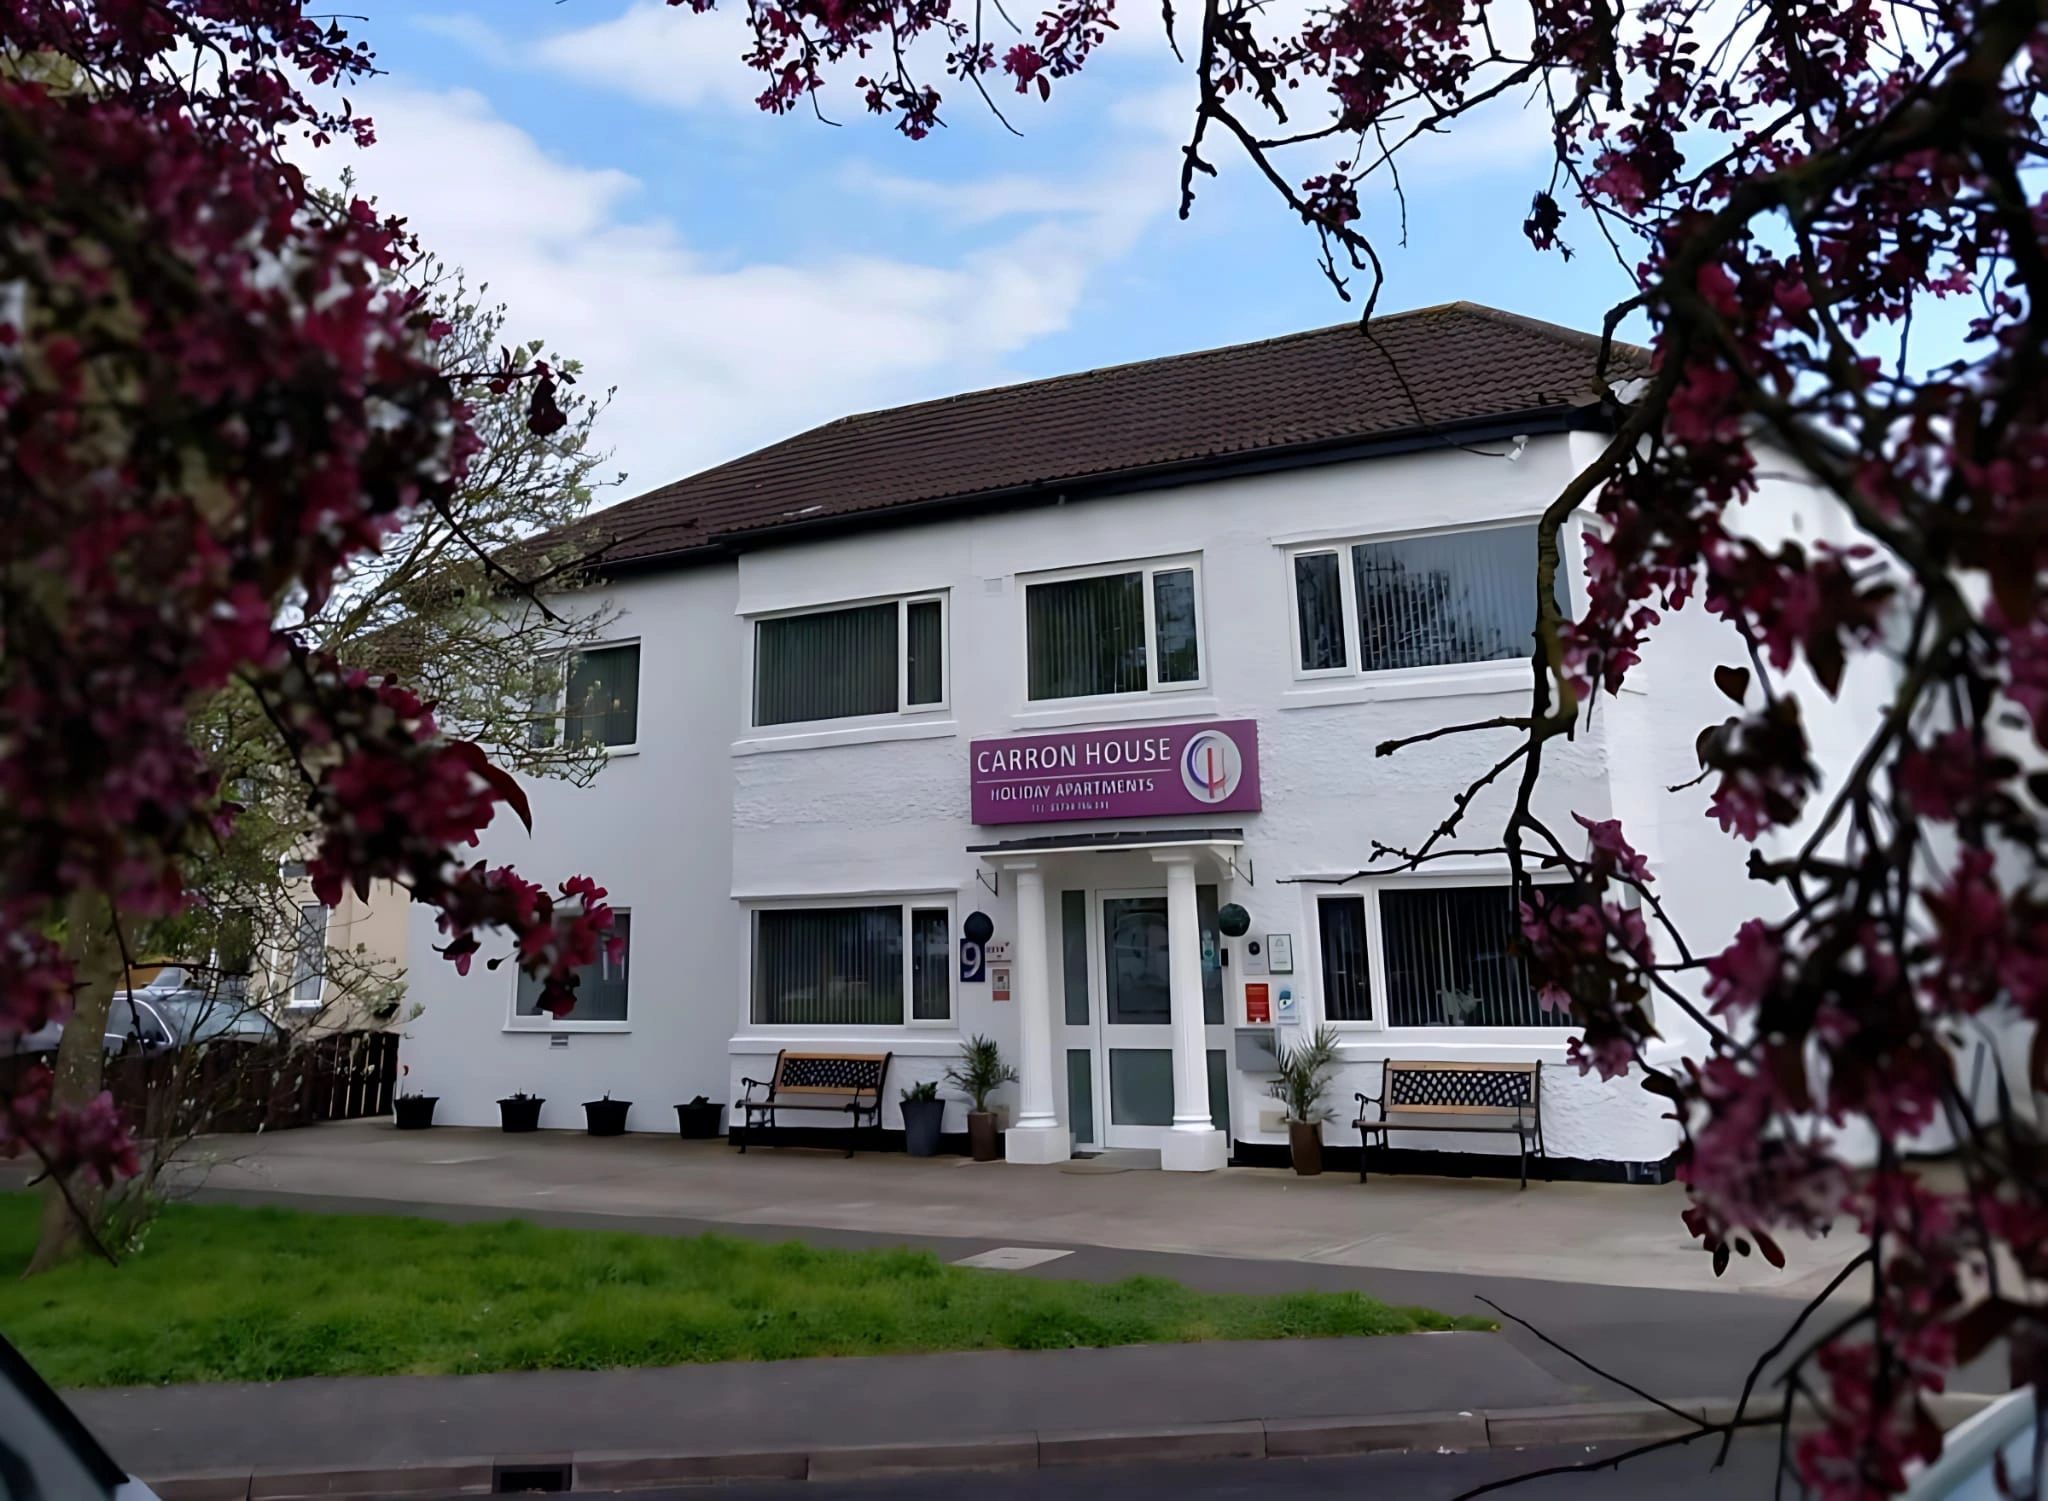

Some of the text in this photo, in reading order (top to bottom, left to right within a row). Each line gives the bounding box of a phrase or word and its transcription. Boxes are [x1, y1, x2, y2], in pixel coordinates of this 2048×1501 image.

[977, 738, 1171, 772] CARRON HOUSE
[991, 778, 1154, 801] HOLIDAY APARTMENTS
[961, 941, 982, 979] 9
